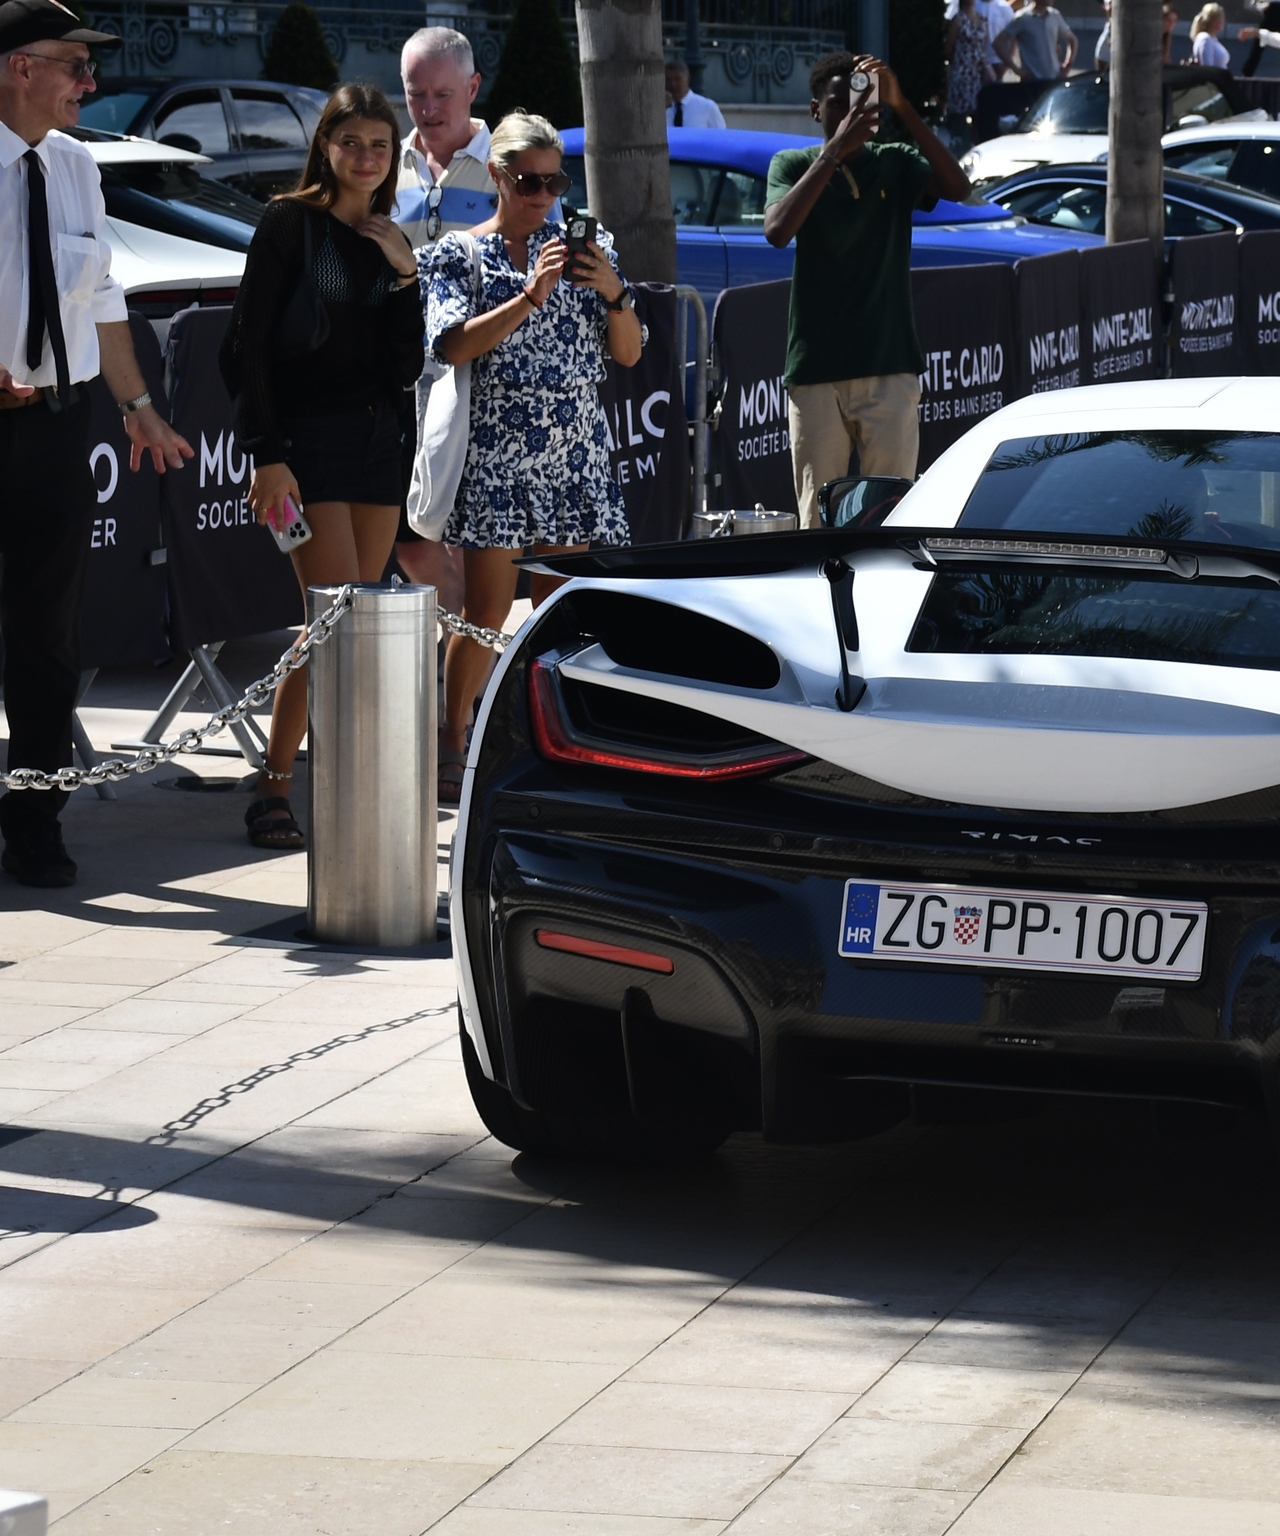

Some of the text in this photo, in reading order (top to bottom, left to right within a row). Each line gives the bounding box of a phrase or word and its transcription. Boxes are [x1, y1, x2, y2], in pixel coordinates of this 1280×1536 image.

[933, 400, 951, 421] DES
[738, 426, 780, 461] SOCIÉTÉ
[197, 491, 256, 531] SOCIÉ
[91, 518, 117, 548] ER
[846, 926, 872, 944] HR
[882, 893, 948, 950] ZG
